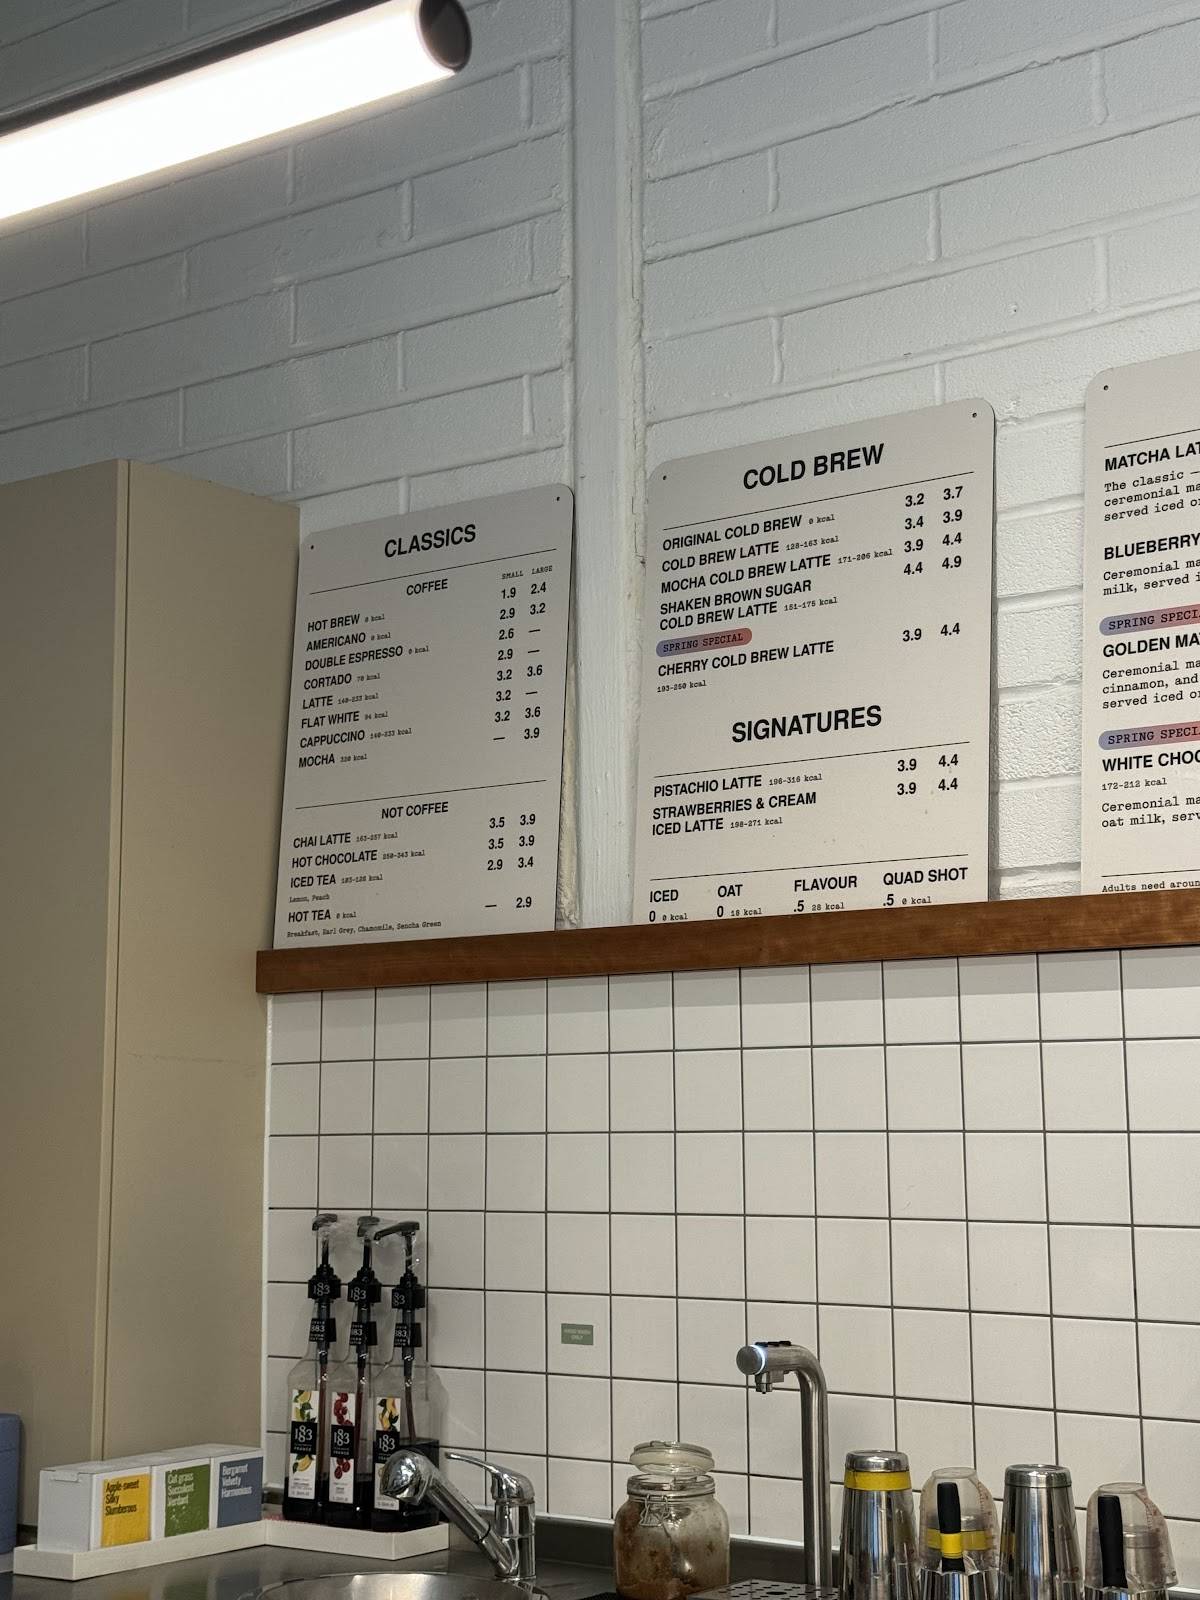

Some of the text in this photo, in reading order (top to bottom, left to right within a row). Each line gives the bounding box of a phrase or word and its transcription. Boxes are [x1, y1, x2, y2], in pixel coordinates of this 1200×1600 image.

[743, 443, 884, 489] COLD BREW
[1105, 447, 1170, 471] MATCHA
[1104, 470, 1184, 492] The classic
[1104, 485, 1180, 506] ceremonial
[662, 485, 963, 550] ORIGINAL COLD BREW 3.2 3.7
[1104, 498, 1184, 521] served iced
[384, 523, 476, 558] CLASSICS
[662, 556, 695, 572] COLD
[699, 548, 736, 566] BREW
[739, 540, 779, 558] LATTE
[820, 535, 839, 544] kcal
[904, 515, 924, 530] 3.4
[942, 509, 962, 523] 3.9
[1104, 532, 1200, 560] BLUEBERRY
[501, 565, 552, 579] SMALL LARGE
[661, 575, 706, 594] MOCHA
[709, 569, 744, 585] COLD
[748, 561, 786, 579] BREW
[790, 553, 831, 572] LATTE
[874, 548, 892, 558] kcal
[904, 538, 923, 552] 3.9
[942, 532, 962, 546] 4.4
[1103, 560, 1180, 581] Ceremonial
[406, 578, 448, 596] COFFEE
[660, 555, 961, 615] SHAKEN BROWN SUGAR 4.4 4.9
[1103, 573, 1189, 596] milk, served
[307, 581, 546, 632] HOT BREW 1.9 2.4
[659, 614, 693, 630] COLD
[697, 608, 734, 624] BREW
[738, 601, 777, 618] LATTE
[819, 596, 837, 606] kcal
[306, 602, 545, 651] AMERICANO 2.9 3.2
[1108, 615, 1155, 630] SPRING
[305, 628, 514, 671] DOUBLE ESPRESSO 2.6
[658, 622, 960, 676] CHERRY COLD BREW LATTE 3.9 4.4
[663, 633, 743, 652] SPRING SPECIAL
[1102, 636, 1170, 657] GOLDEN
[303, 648, 513, 690] CORTADO 2.9
[1102, 660, 1179, 679] Ceremonial
[302, 664, 542, 709] LATTE 3.2 3.6
[689, 679, 706, 688] kcal
[1102, 672, 1198, 694] cinnamon, and
[301, 689, 511, 728] FLAT WHITE 3.2
[1102, 690, 1183, 709] served iced
[300, 706, 540, 748] CAPPUCCINO 3.2 3.6
[732, 704, 881, 743] SIGNATURES
[298, 727, 540, 768] MOCHA 3.9
[1108, 731, 1154, 744] SPRING
[1102, 754, 1153, 772] WHITE
[654, 753, 958, 797] PISTACHIO LATTE 3.9 4.4
[1144, 777, 1167, 786] kcal
[652, 777, 958, 820] STRAWBERRIES & CREAM 3.9 4.4
[1101, 796, 1179, 812] Ceremonial
[381, 801, 448, 819] NOT COFFEE
[1101, 813, 1165, 827] oat milk,
[293, 813, 536, 848] CHAI LATTE 3.5 3.9
[652, 817, 723, 836] ICED LATTE
[292, 834, 535, 868] HOT CHOCOLATE 3.5 3.9
[290, 856, 533, 888] ICED TEA 2.9 3.4
[883, 867, 968, 885] QUAD SHOT
[717, 884, 743, 897] OAT
[794, 875, 857, 892] FLAVOUR
[1101, 880, 1165, 892] Adults need
[649, 889, 678, 902] ICED
[793, 899, 804, 912] .5
[883, 893, 894, 906] .5
[288, 896, 532, 922] HOT TEA 2.9
[649, 910, 656, 921] 0
[716, 905, 724, 917] 0
